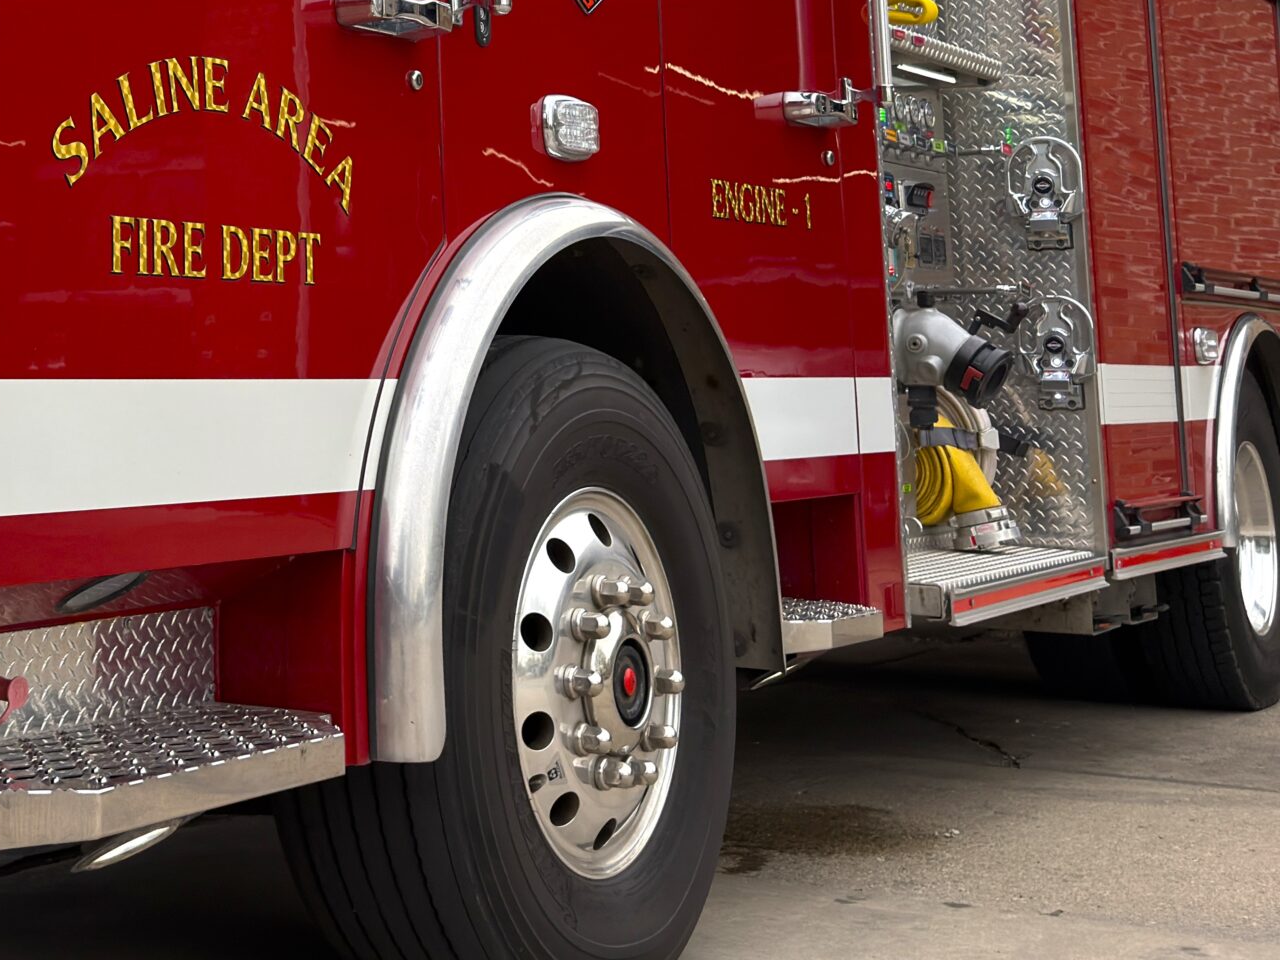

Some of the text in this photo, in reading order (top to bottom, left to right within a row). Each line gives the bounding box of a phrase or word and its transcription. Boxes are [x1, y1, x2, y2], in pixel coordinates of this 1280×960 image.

[51, 55, 354, 216] SALINE AREA
[710, 178, 788, 227] ENGINE
[109, 214, 322, 286] FIRE DEPT
